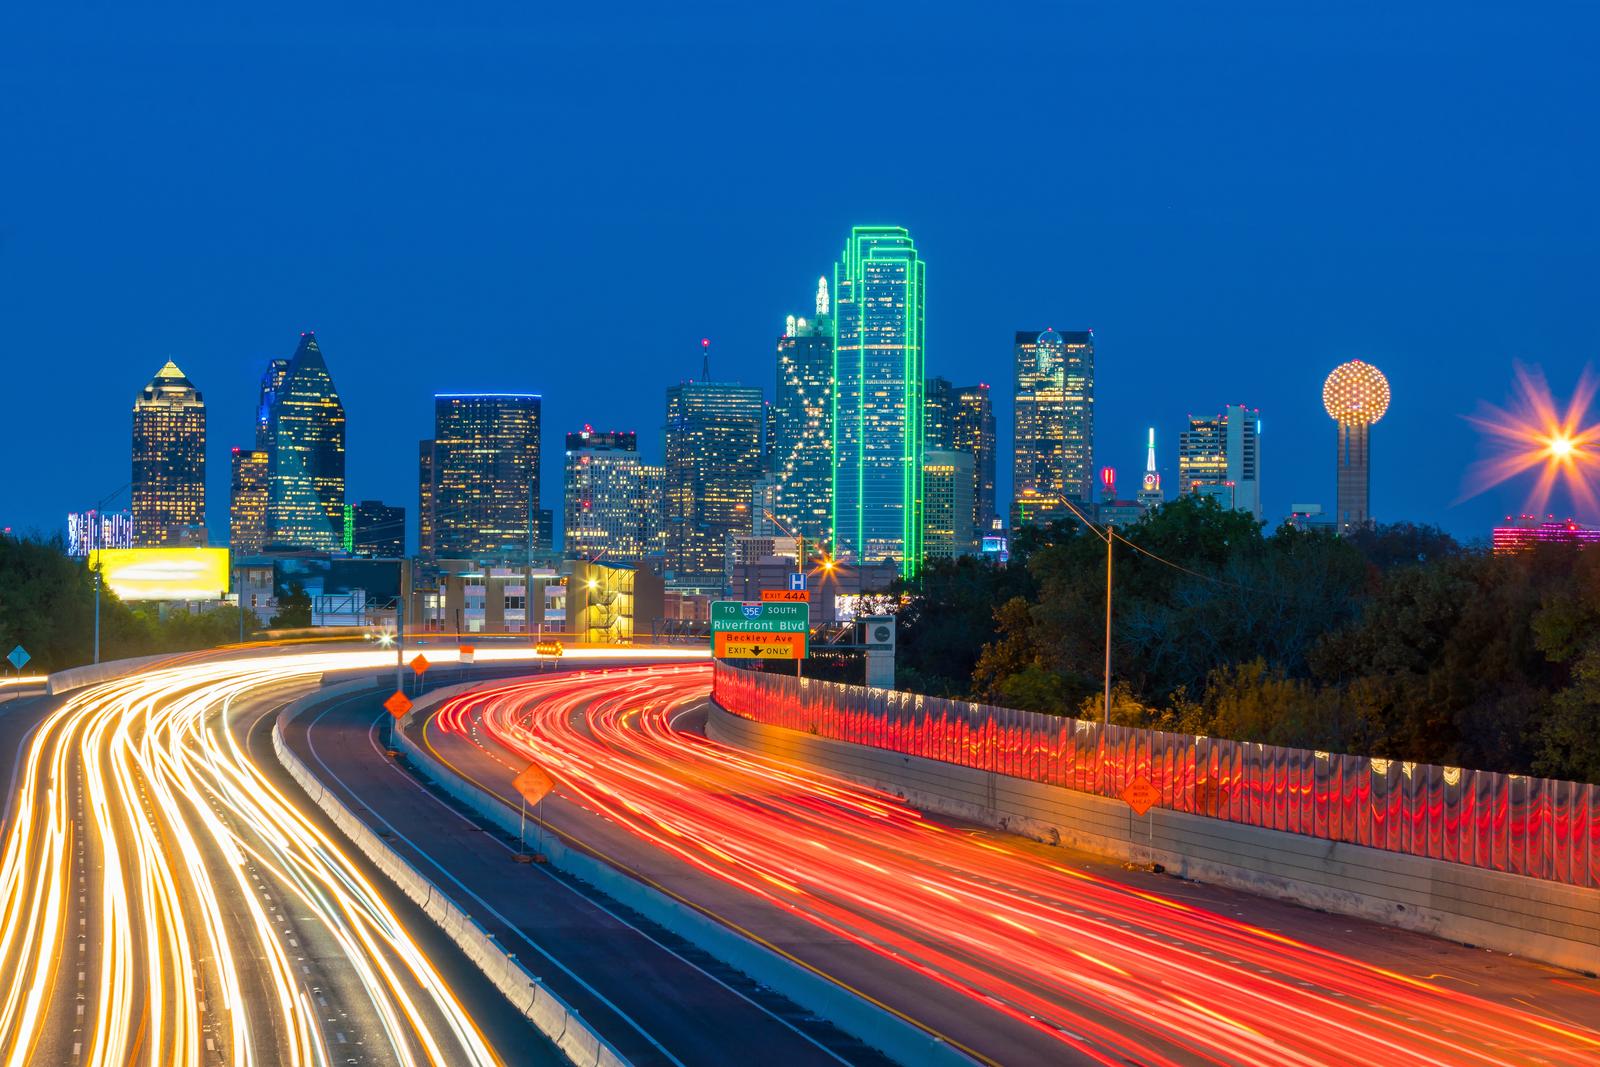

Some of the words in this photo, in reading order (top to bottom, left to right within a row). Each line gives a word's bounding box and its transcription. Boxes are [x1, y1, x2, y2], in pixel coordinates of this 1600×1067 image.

[792, 574, 804, 590] H
[784, 592, 806, 600] 44A
[744, 607, 759, 616] 35E
[768, 606, 797, 614] SOUTH
[714, 620, 773, 630] Riverfront
[779, 621, 805, 631] Blvd
[726, 634, 767, 643] Beckley
[766, 647, 789, 655] ONLY
